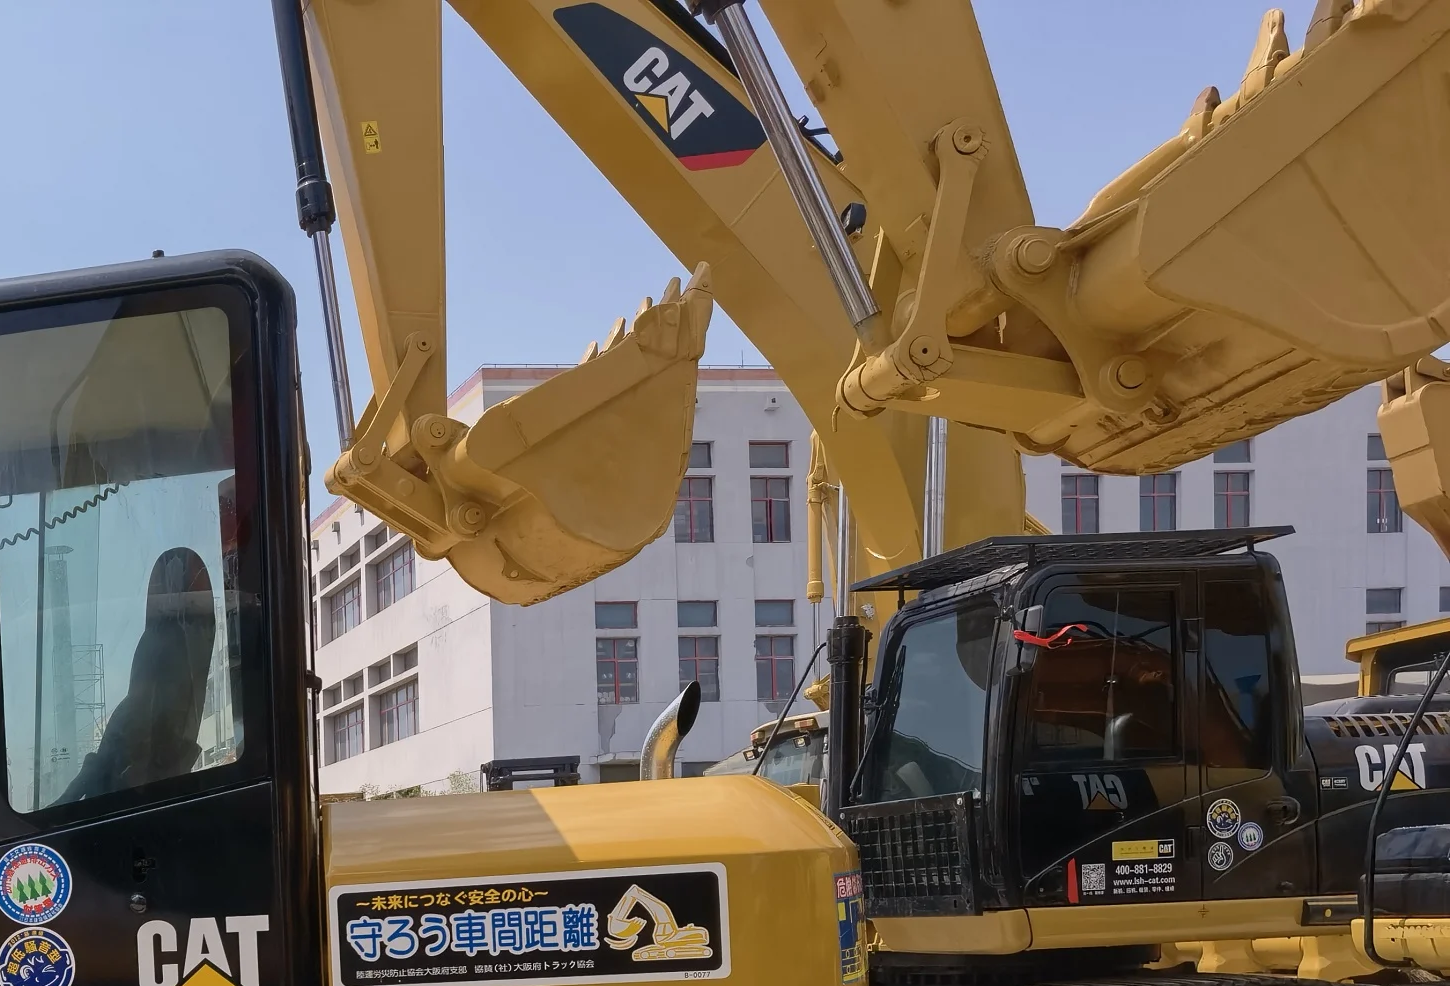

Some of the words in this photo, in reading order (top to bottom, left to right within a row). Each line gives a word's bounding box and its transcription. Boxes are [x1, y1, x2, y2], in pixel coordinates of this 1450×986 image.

[623, 47, 715, 141] CAT
[1354, 743, 1427, 791] CAT
[1158, 844, 1173, 854] CAT
[1115, 863, 1173, 876] 400-881-8829
[1113, 877, 1176, 886] www.lsh-cat.com
[347, 904, 599, 960] 守ろう車間距離
[684, 971, 711, 979] B-0077
